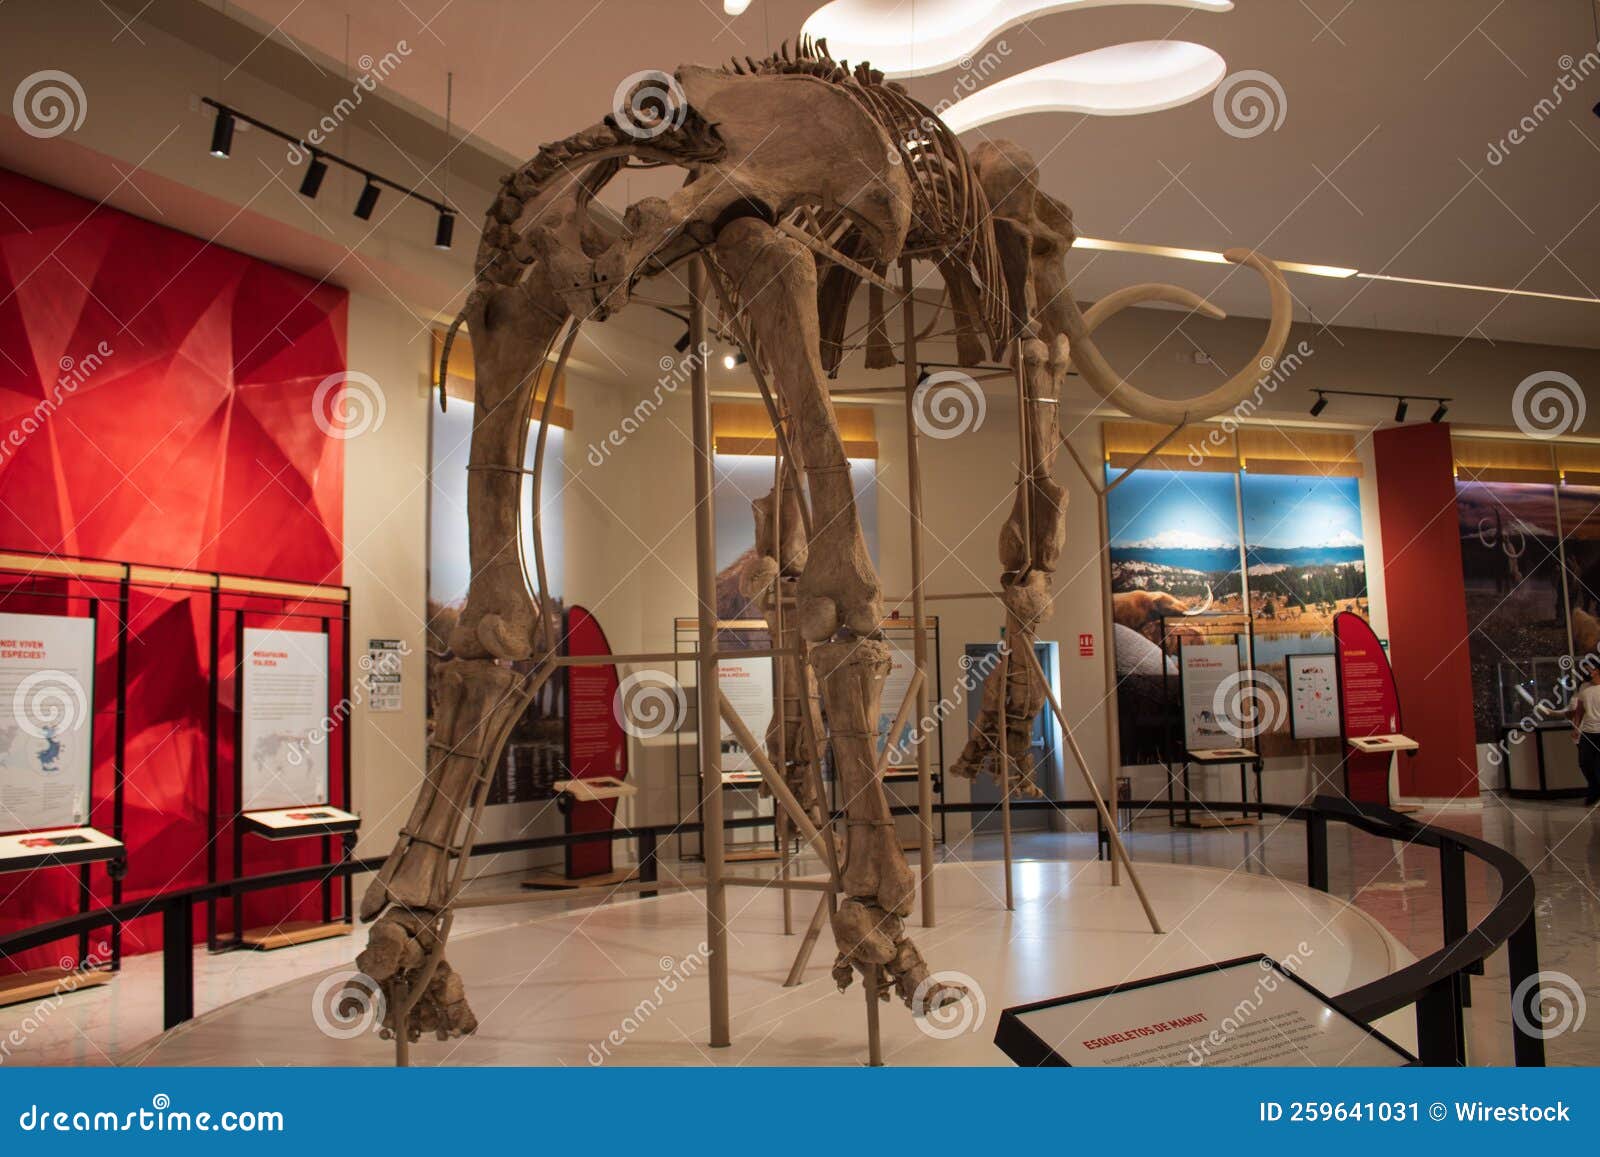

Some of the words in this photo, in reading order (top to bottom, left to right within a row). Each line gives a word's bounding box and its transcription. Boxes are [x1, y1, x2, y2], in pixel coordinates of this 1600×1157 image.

[1083, 1026, 1156, 1050] ESQUELETOS
[1152, 1022, 1171, 1033] DE
[1168, 1013, 1208, 1029] MAMUT
